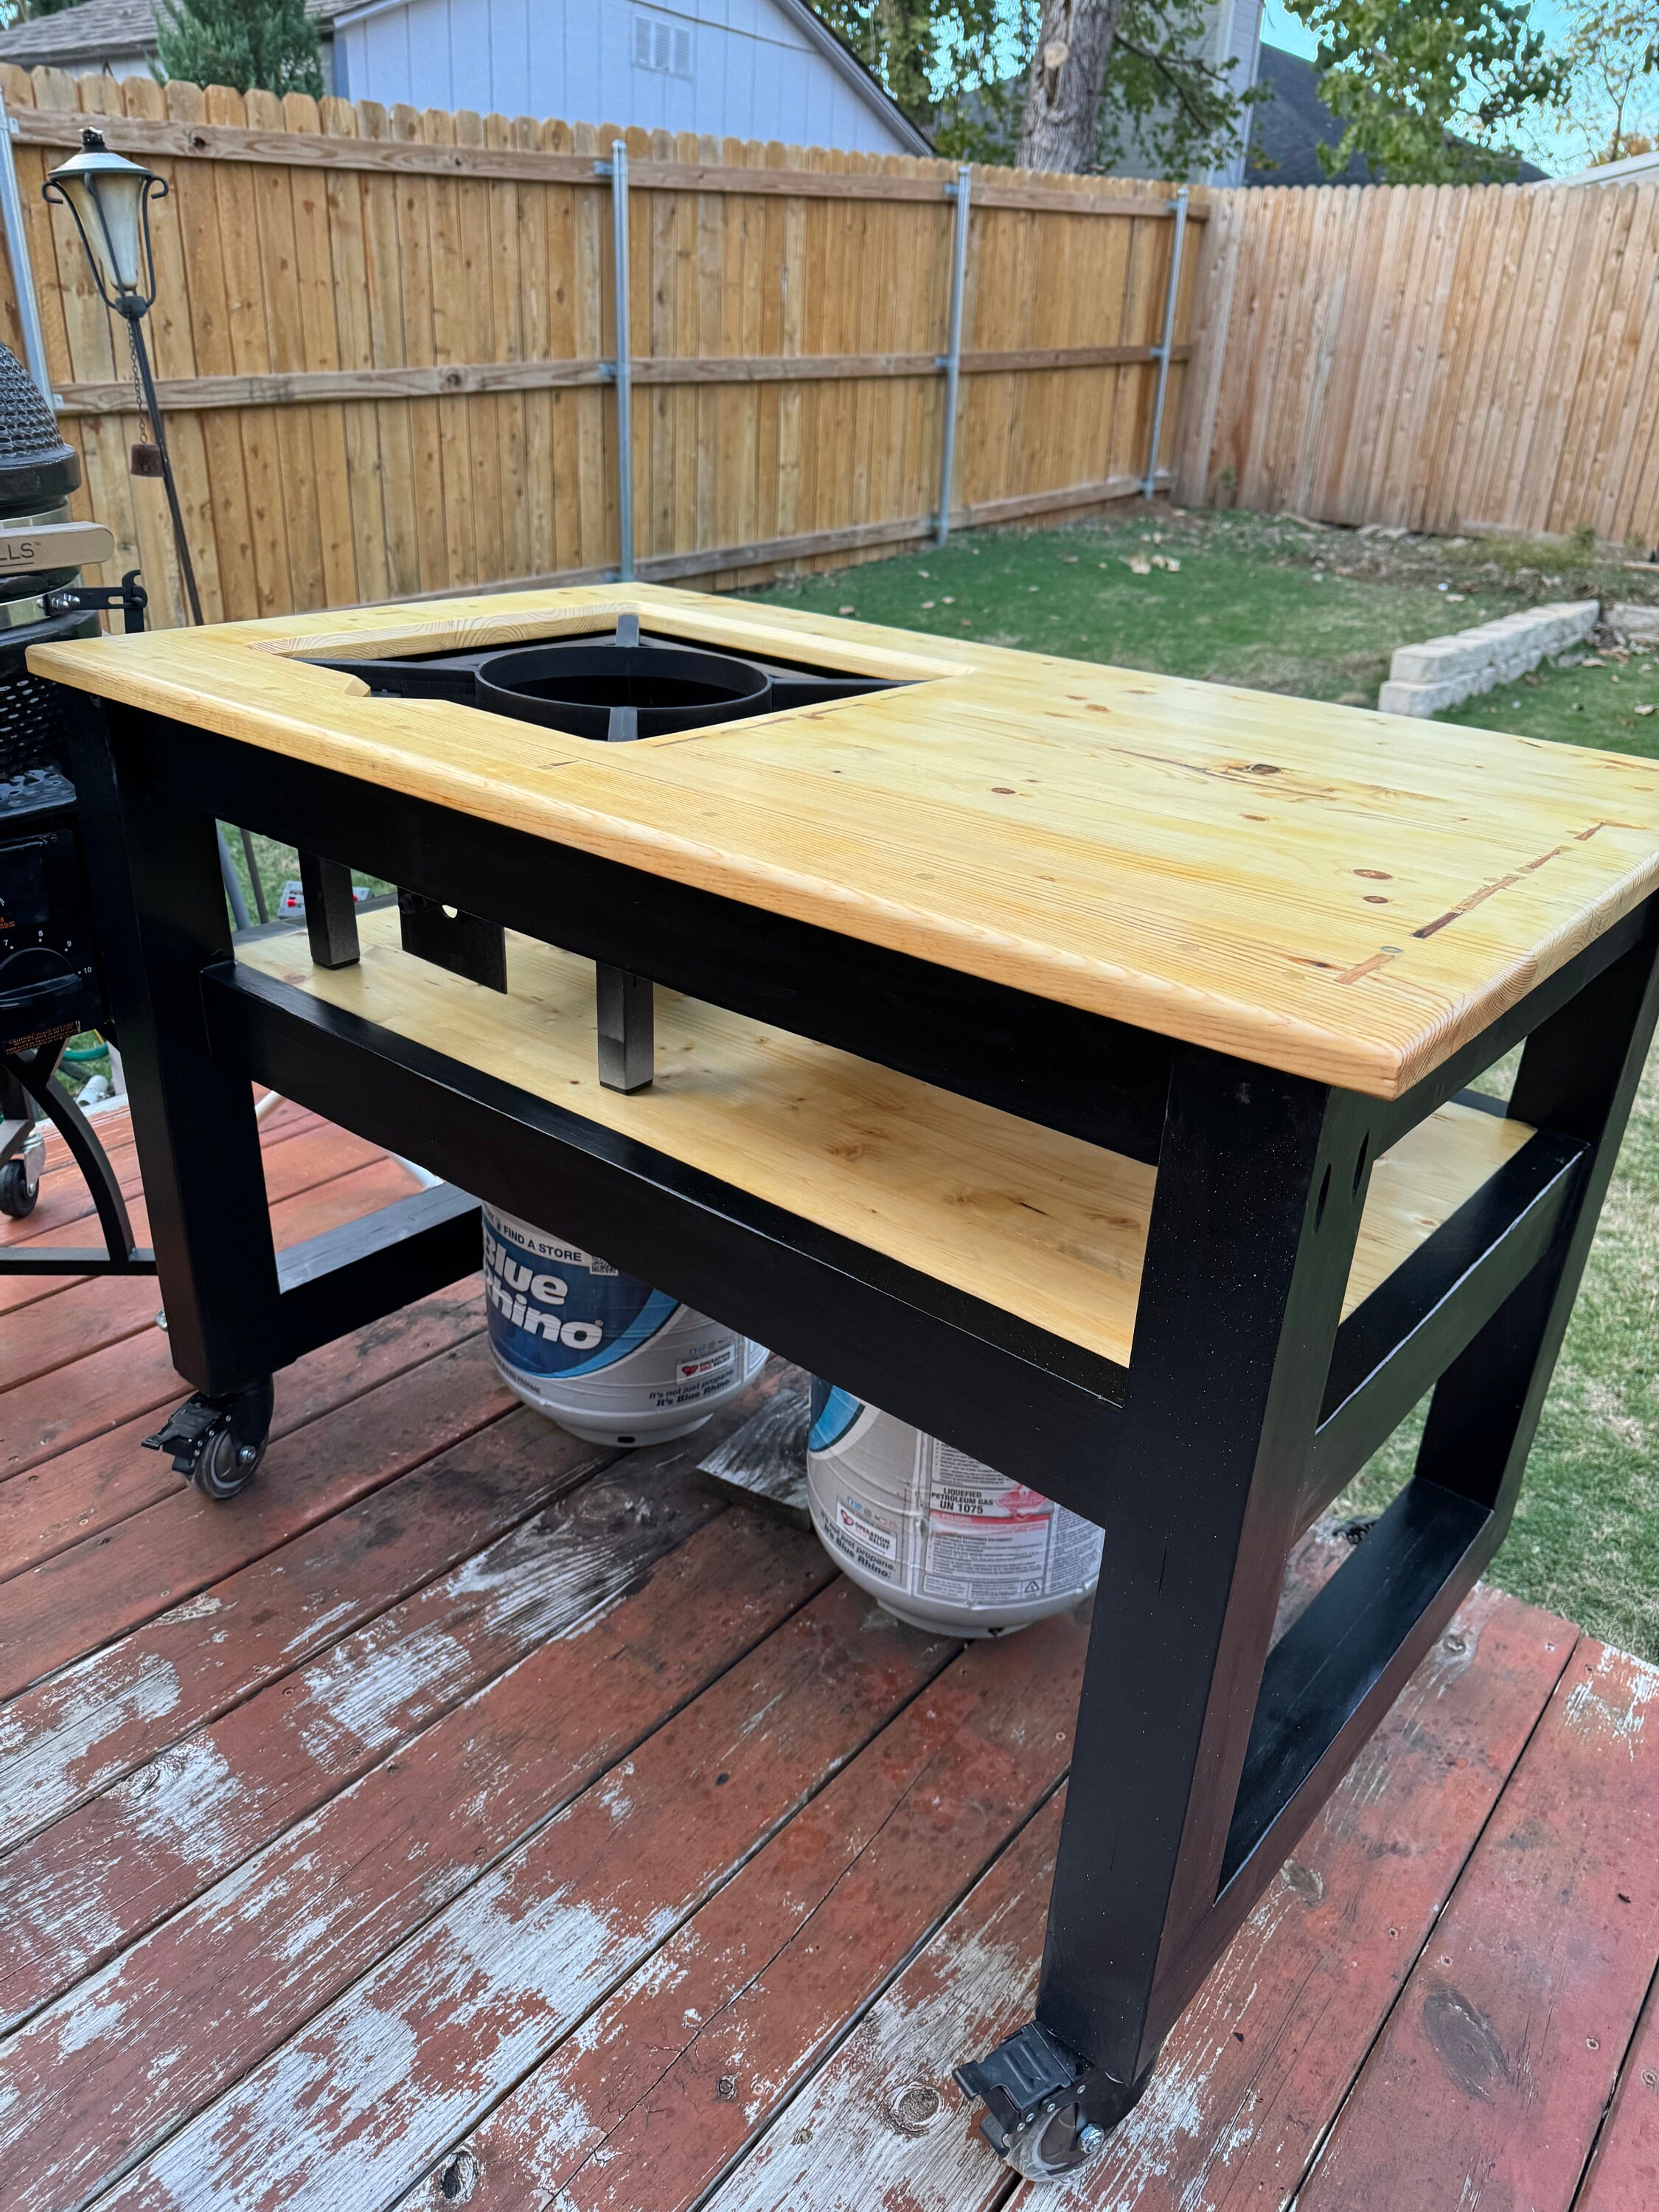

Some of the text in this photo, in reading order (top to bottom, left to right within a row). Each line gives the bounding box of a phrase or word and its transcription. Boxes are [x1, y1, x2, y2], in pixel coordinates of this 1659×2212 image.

[83, 966, 92, 974] 10
[504, 1225, 582, 1262] FIND A STORE
[484, 1230, 568, 1305] Blue
[666, 1388, 681, 1397] not
[683, 1382, 700, 1394] just
[677, 1391, 700, 1403] Blue
[931, 1492, 976, 1505] PETROLEUM
[943, 1487, 982, 1498] LIQUEFIED
[939, 1500, 984, 1514] UN 1075
[836, 1537, 855, 1559] Blue
